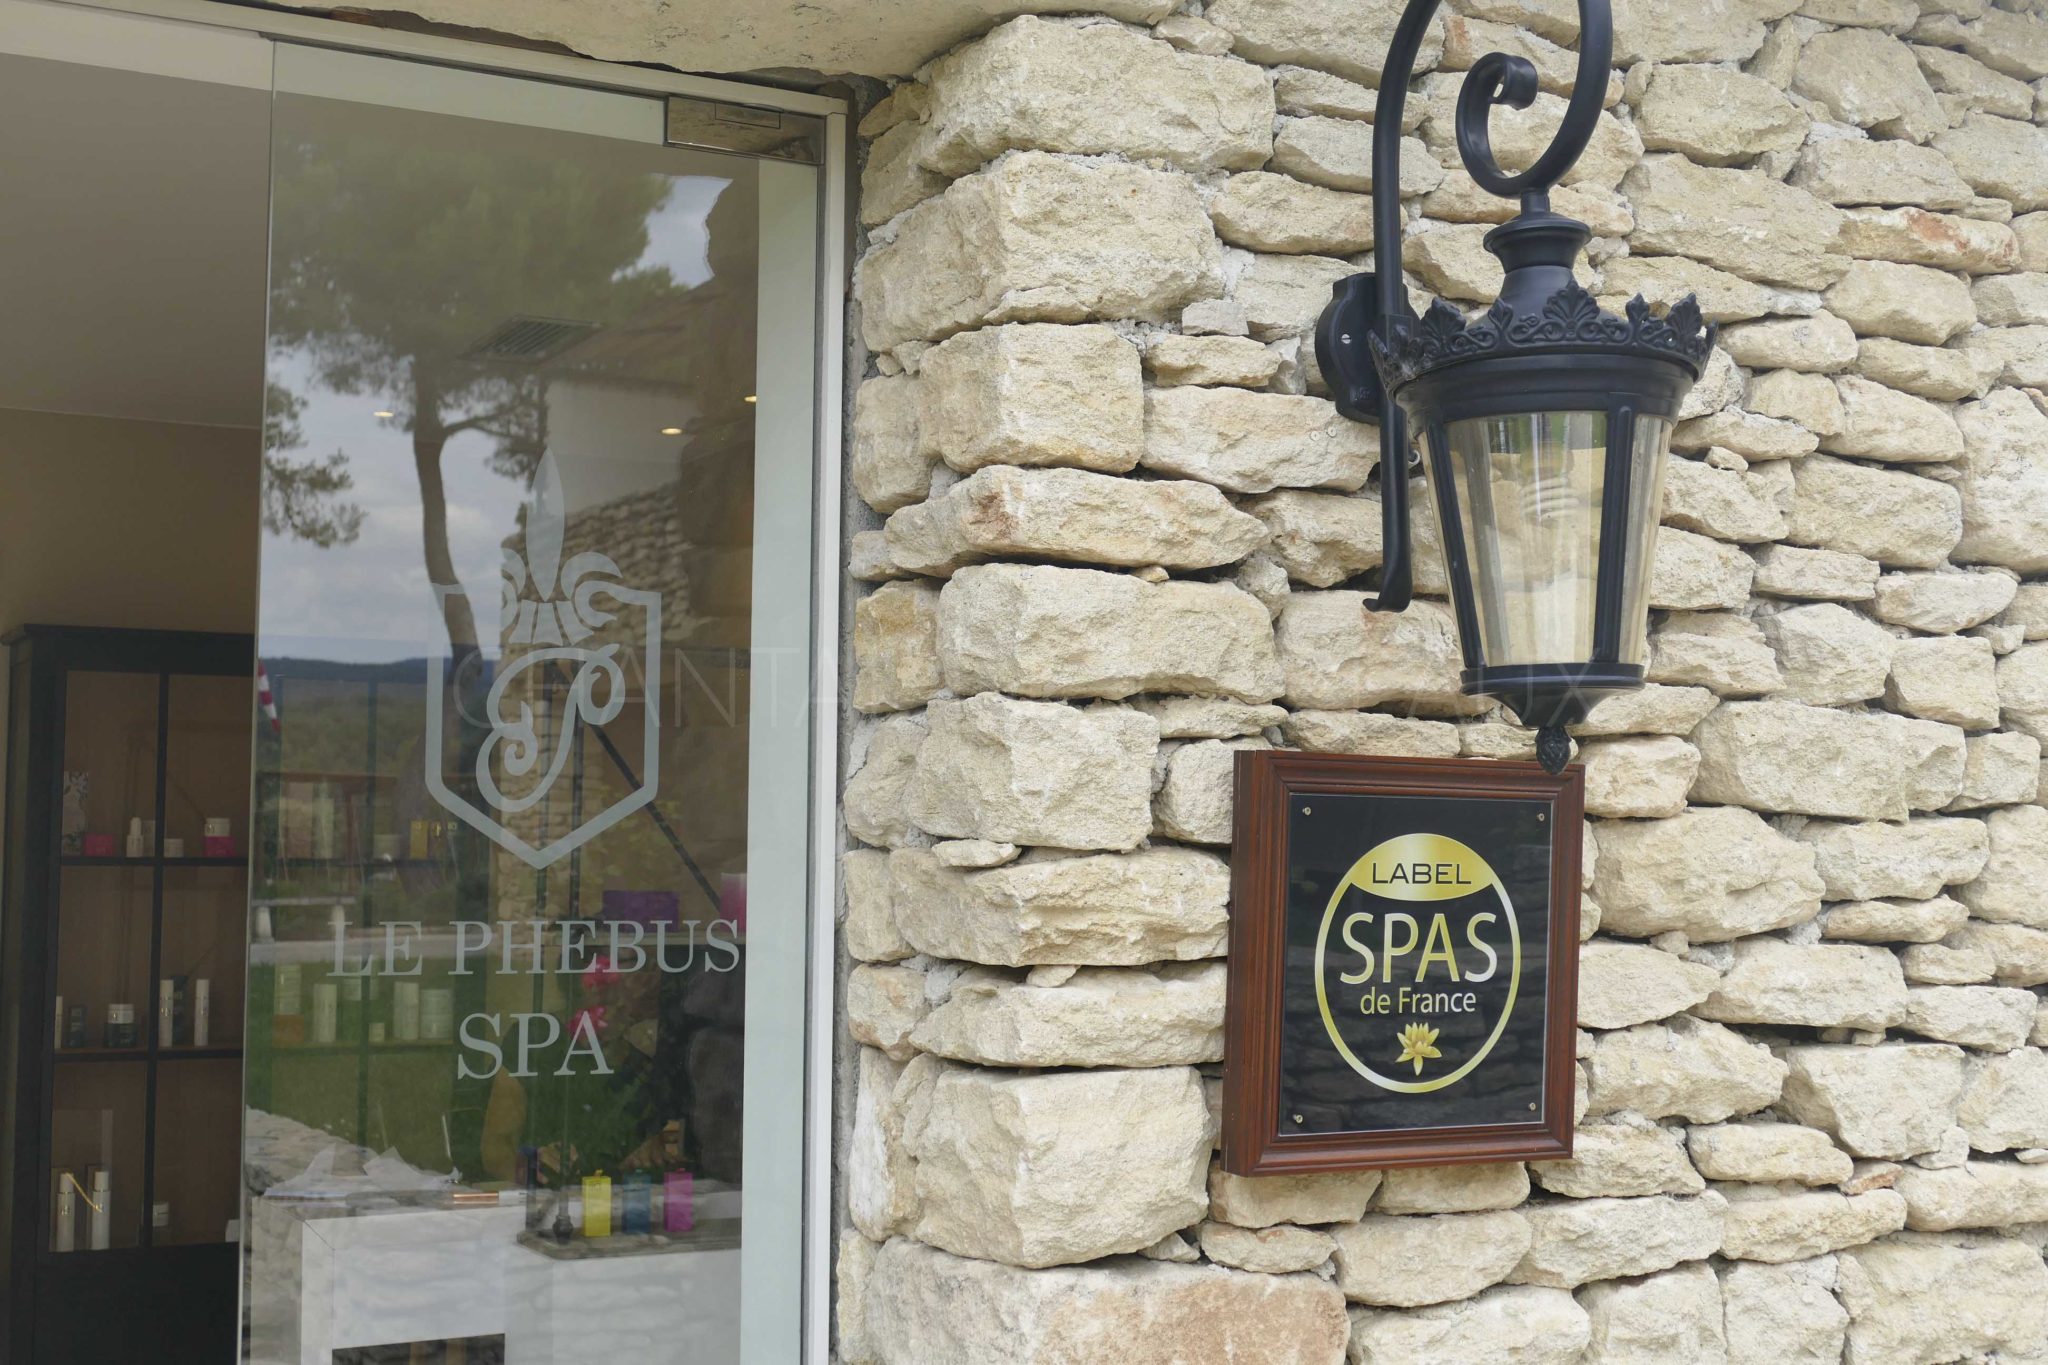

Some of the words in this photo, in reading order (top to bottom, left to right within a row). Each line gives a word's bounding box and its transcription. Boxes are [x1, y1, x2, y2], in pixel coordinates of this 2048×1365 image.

[1371, 862, 1472, 885] LABEL
[326, 920, 424, 977] LE
[447, 918, 741, 976] PHEBUS
[1339, 912, 1498, 985] SPAS
[1359, 987, 1391, 1015] de
[1397, 986, 1477, 1014] France
[456, 1010, 615, 1080] SPA
